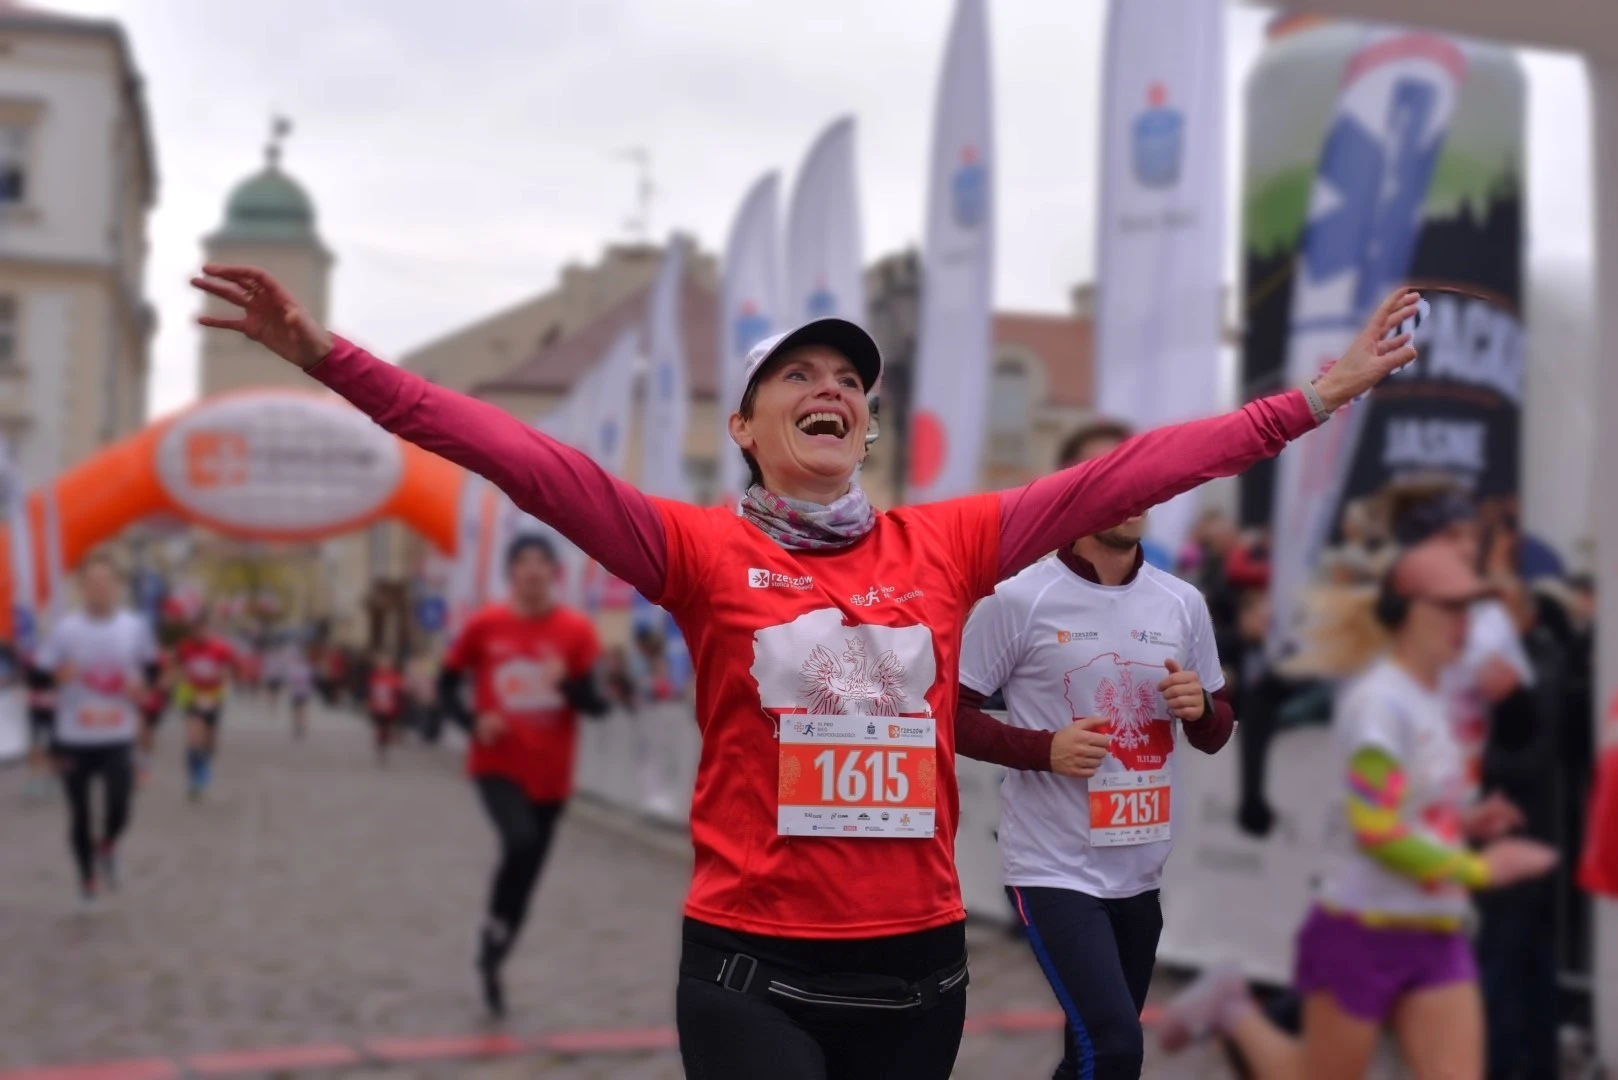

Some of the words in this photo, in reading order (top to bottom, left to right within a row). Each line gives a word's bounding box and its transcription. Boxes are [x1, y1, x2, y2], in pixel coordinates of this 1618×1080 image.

[1384, 418, 1486, 470] JASNE
[771, 573, 813, 586] rzeszów
[814, 749, 909, 803] 1615
[1110, 790, 1160, 825] 2151
